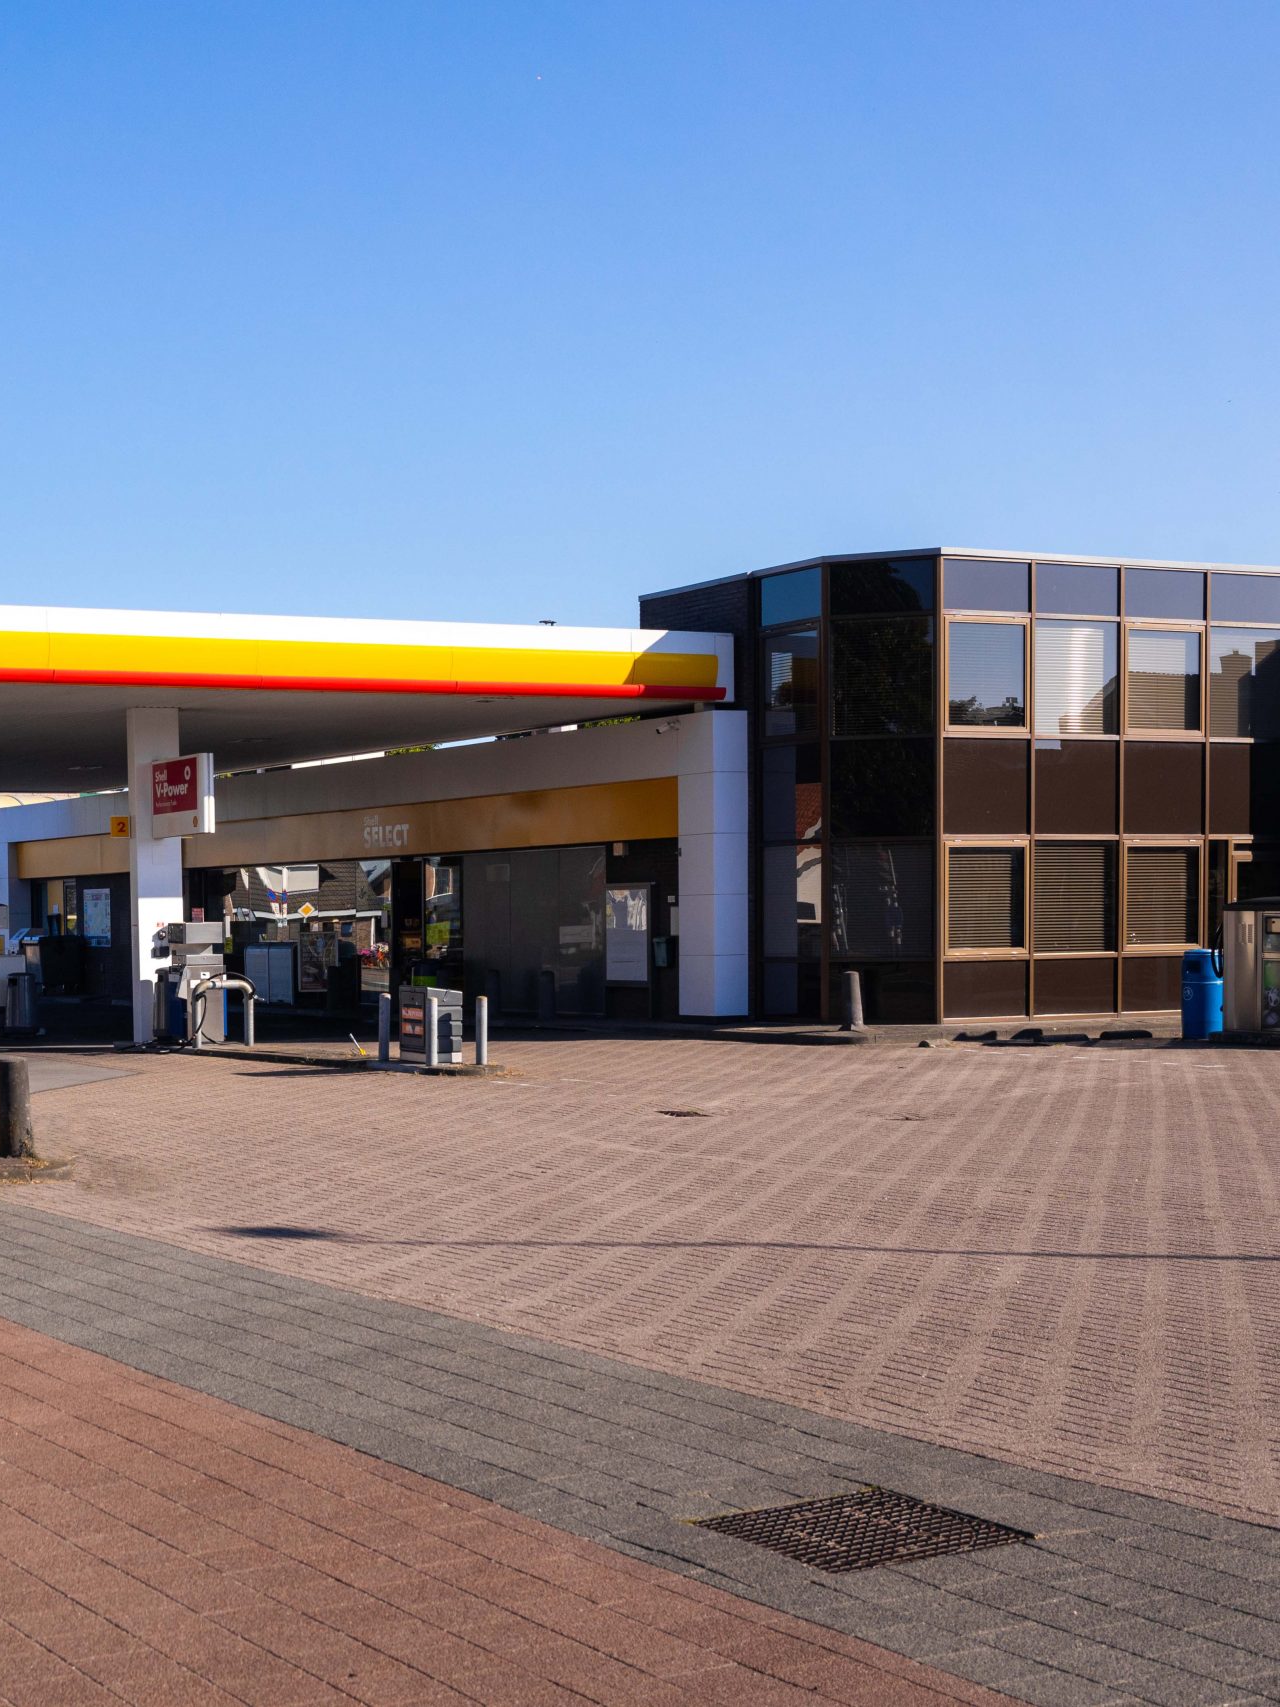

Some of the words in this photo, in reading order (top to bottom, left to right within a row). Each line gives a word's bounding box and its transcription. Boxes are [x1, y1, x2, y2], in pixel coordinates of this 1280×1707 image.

[155, 769, 167, 782] Shell
[155, 783, 188, 798] V-Power
[117, 822, 126, 833] 2
[363, 824, 410, 849] SELECT
